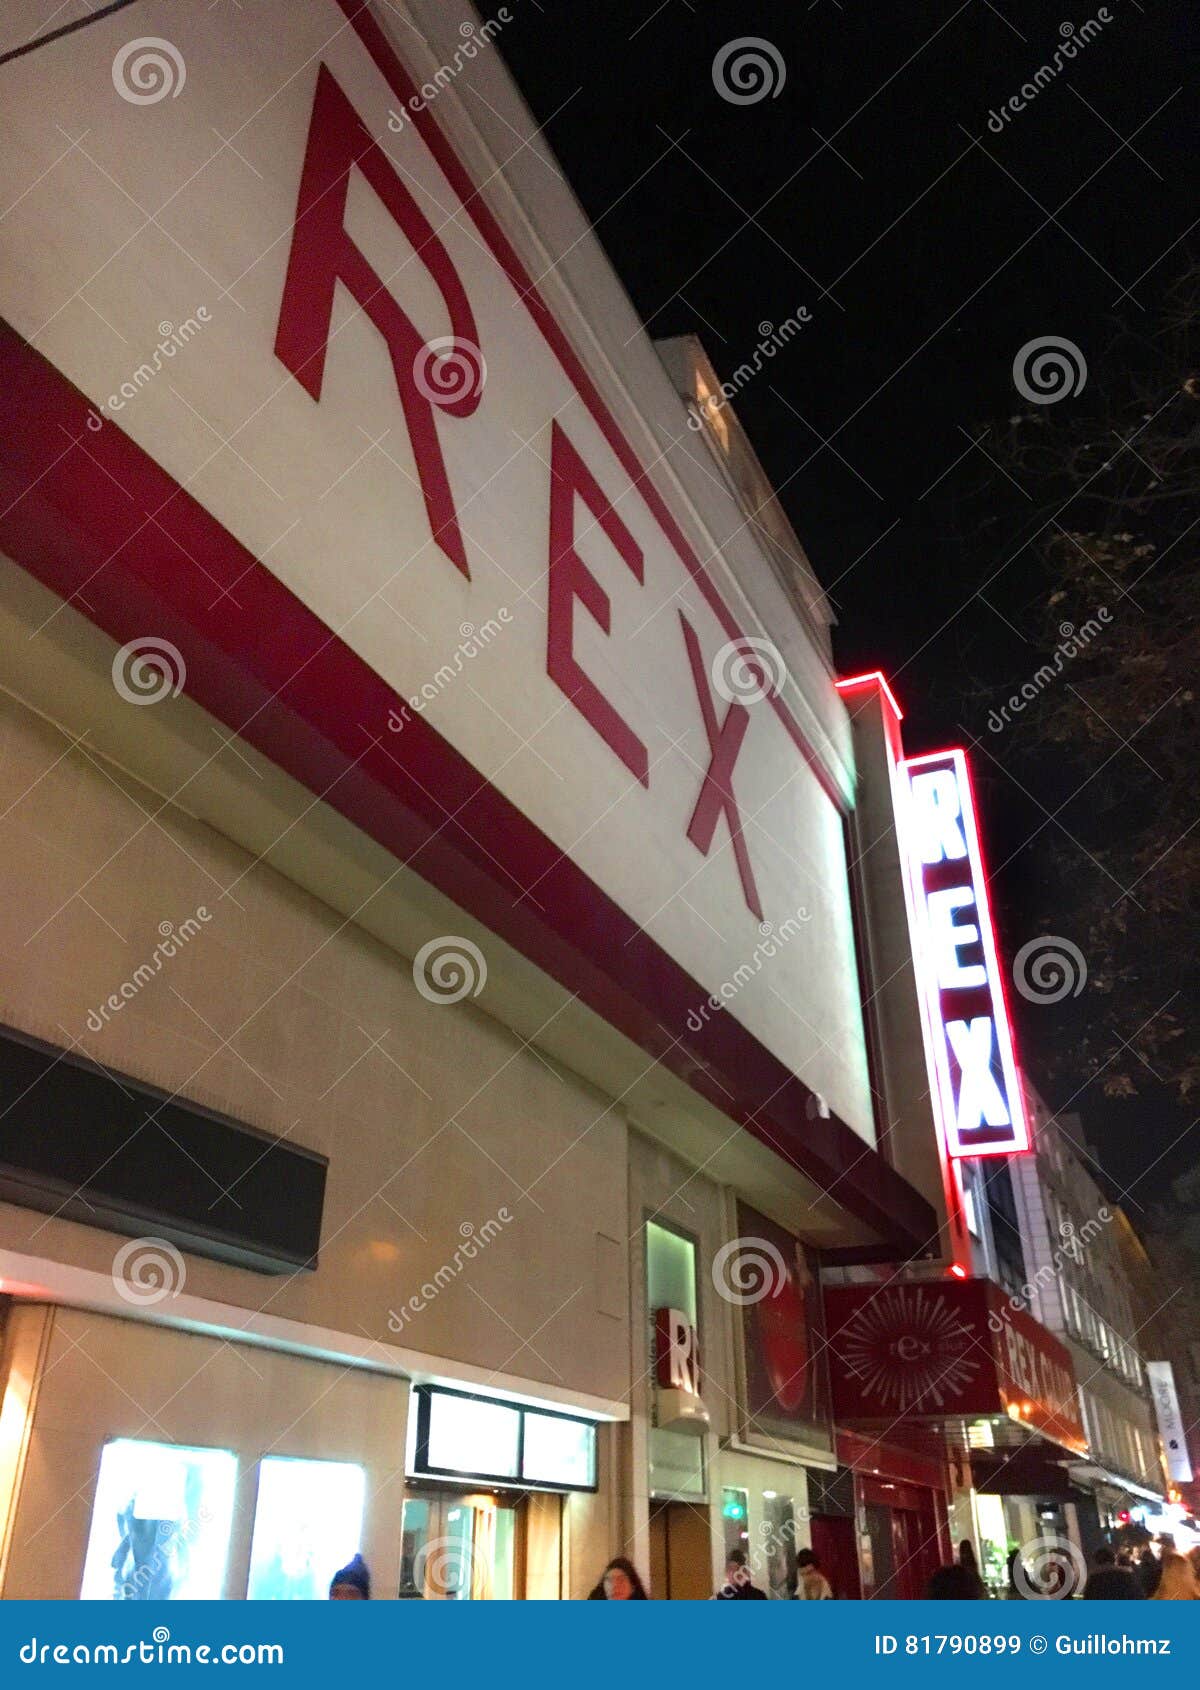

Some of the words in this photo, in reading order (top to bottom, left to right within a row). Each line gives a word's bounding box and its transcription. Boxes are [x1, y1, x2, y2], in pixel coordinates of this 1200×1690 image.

[274, 61, 763, 922] REX
[911, 769, 1010, 1130] REX
[1004, 1321, 1041, 1401] REX
